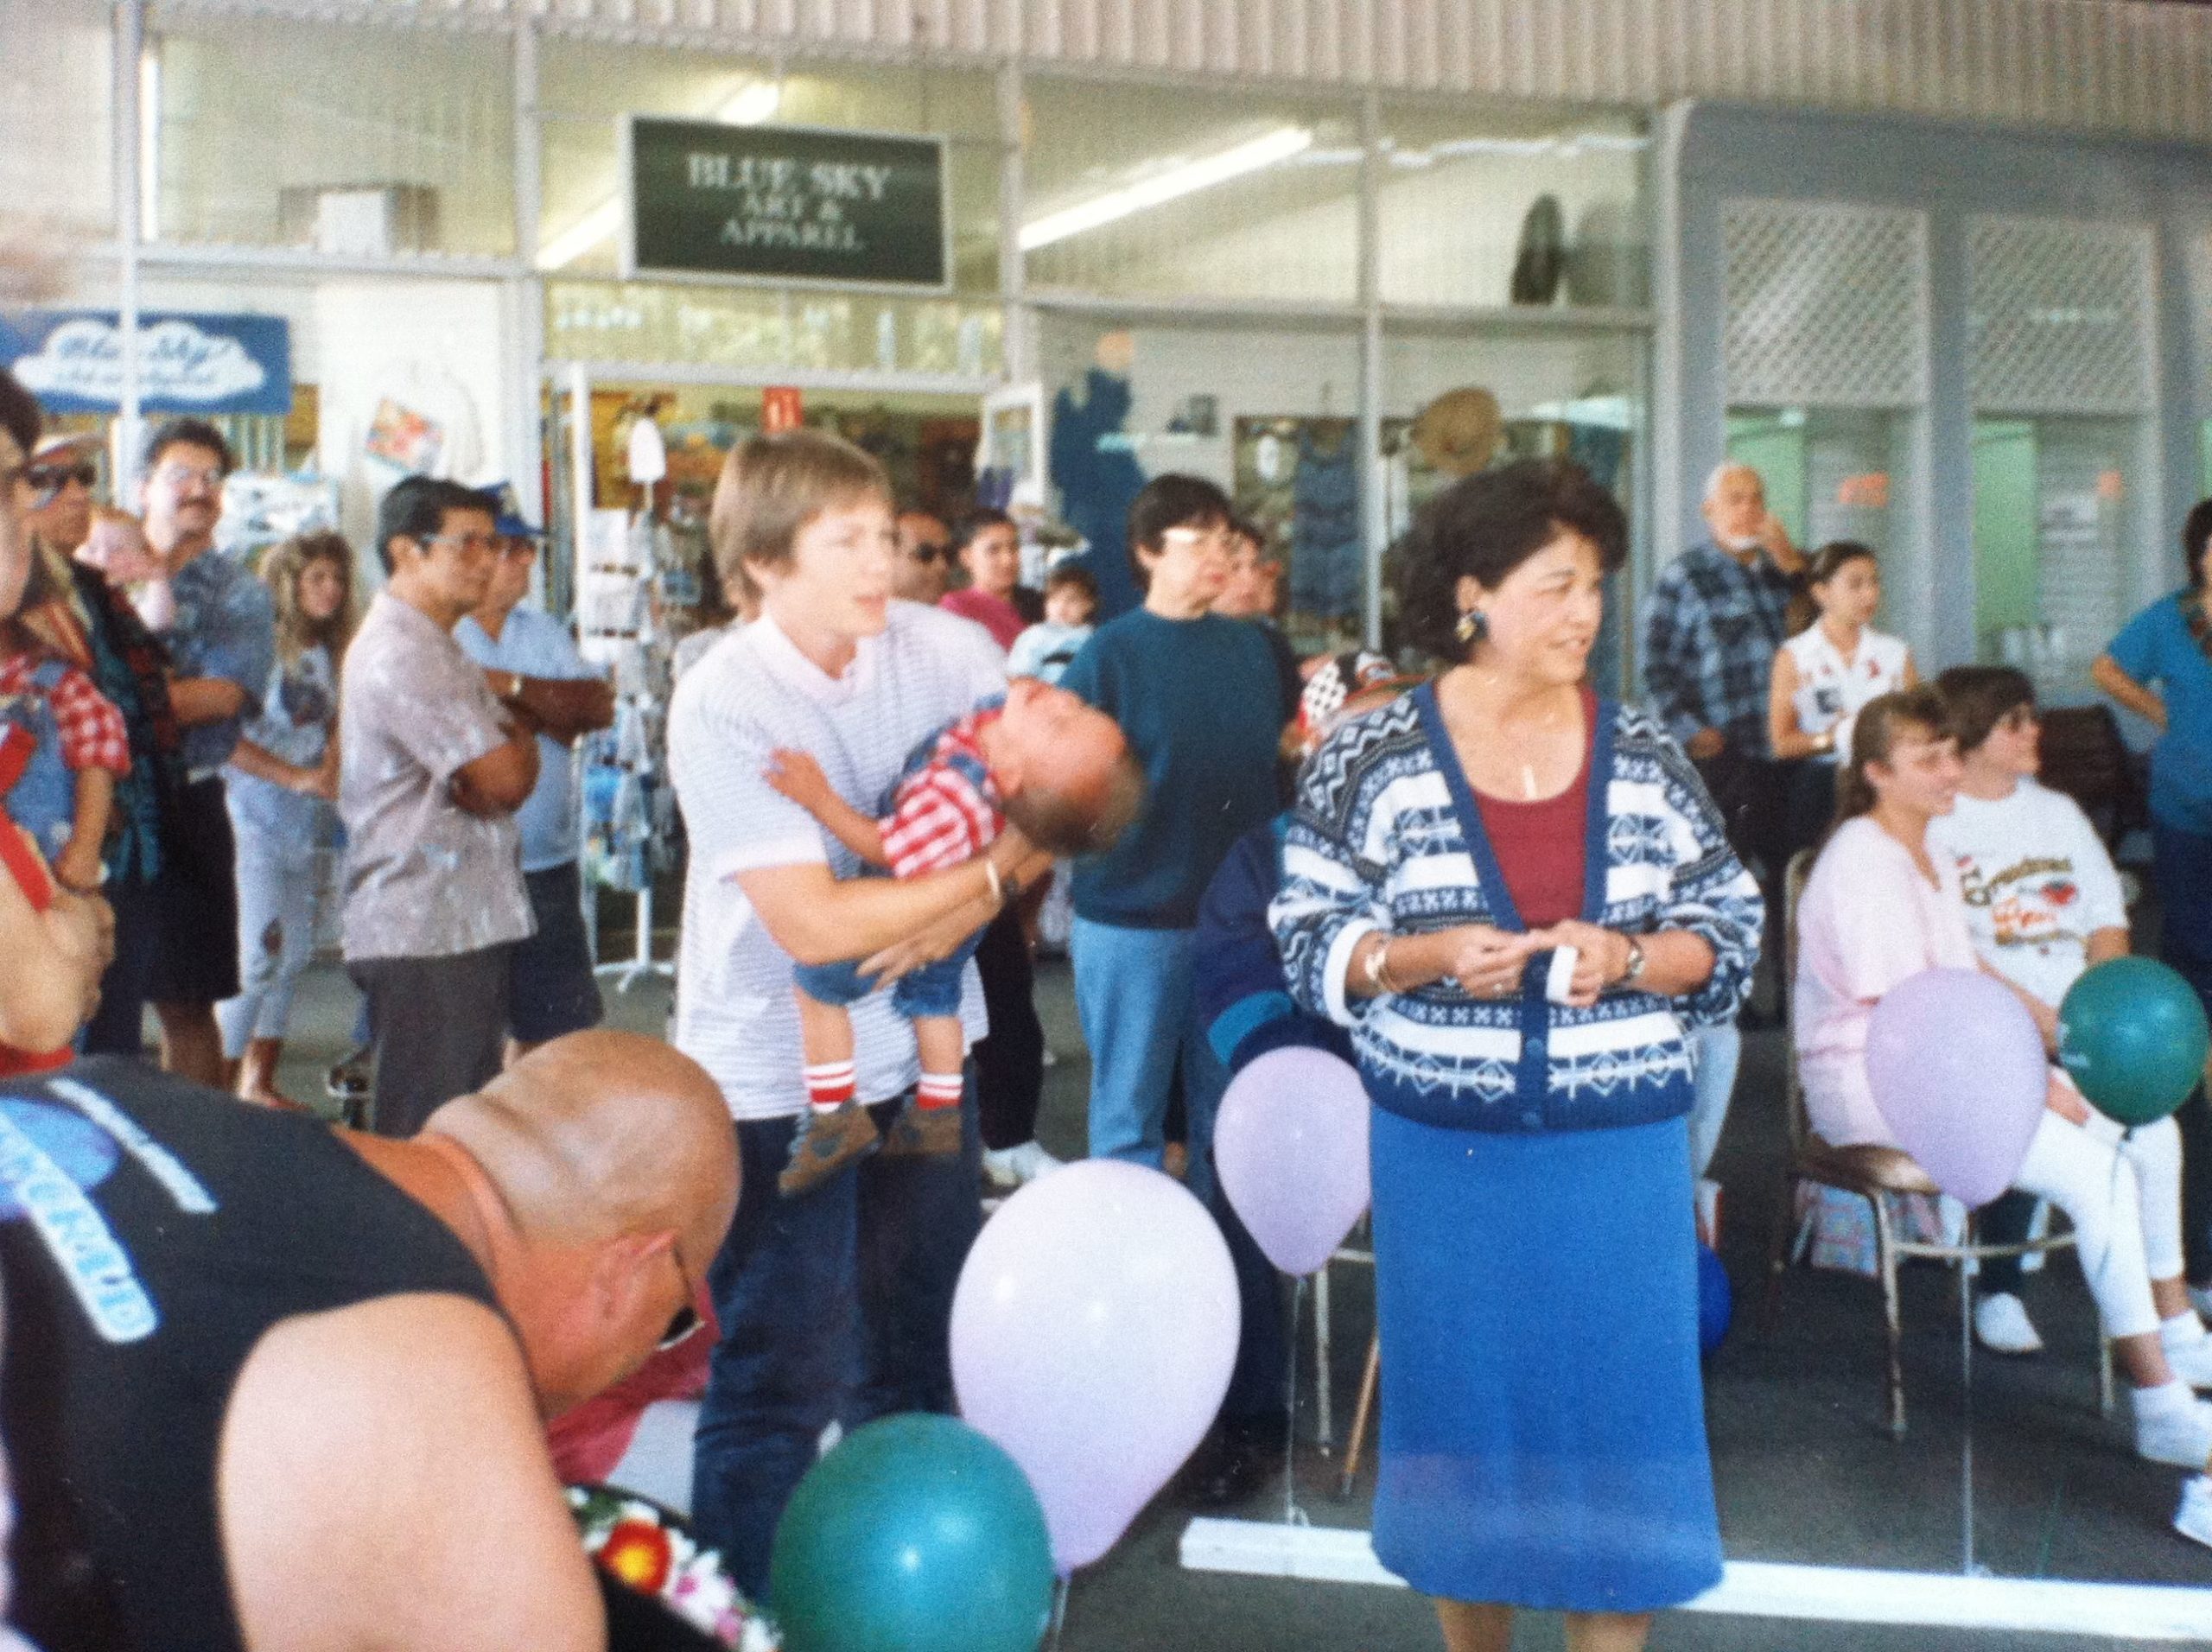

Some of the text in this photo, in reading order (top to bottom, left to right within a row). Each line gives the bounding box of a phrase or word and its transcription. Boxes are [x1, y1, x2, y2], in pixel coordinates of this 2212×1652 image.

[688, 151, 893, 200] BLUE SKY
[743, 192, 844, 223] ART &
[721, 216, 864, 251] APPAREL
